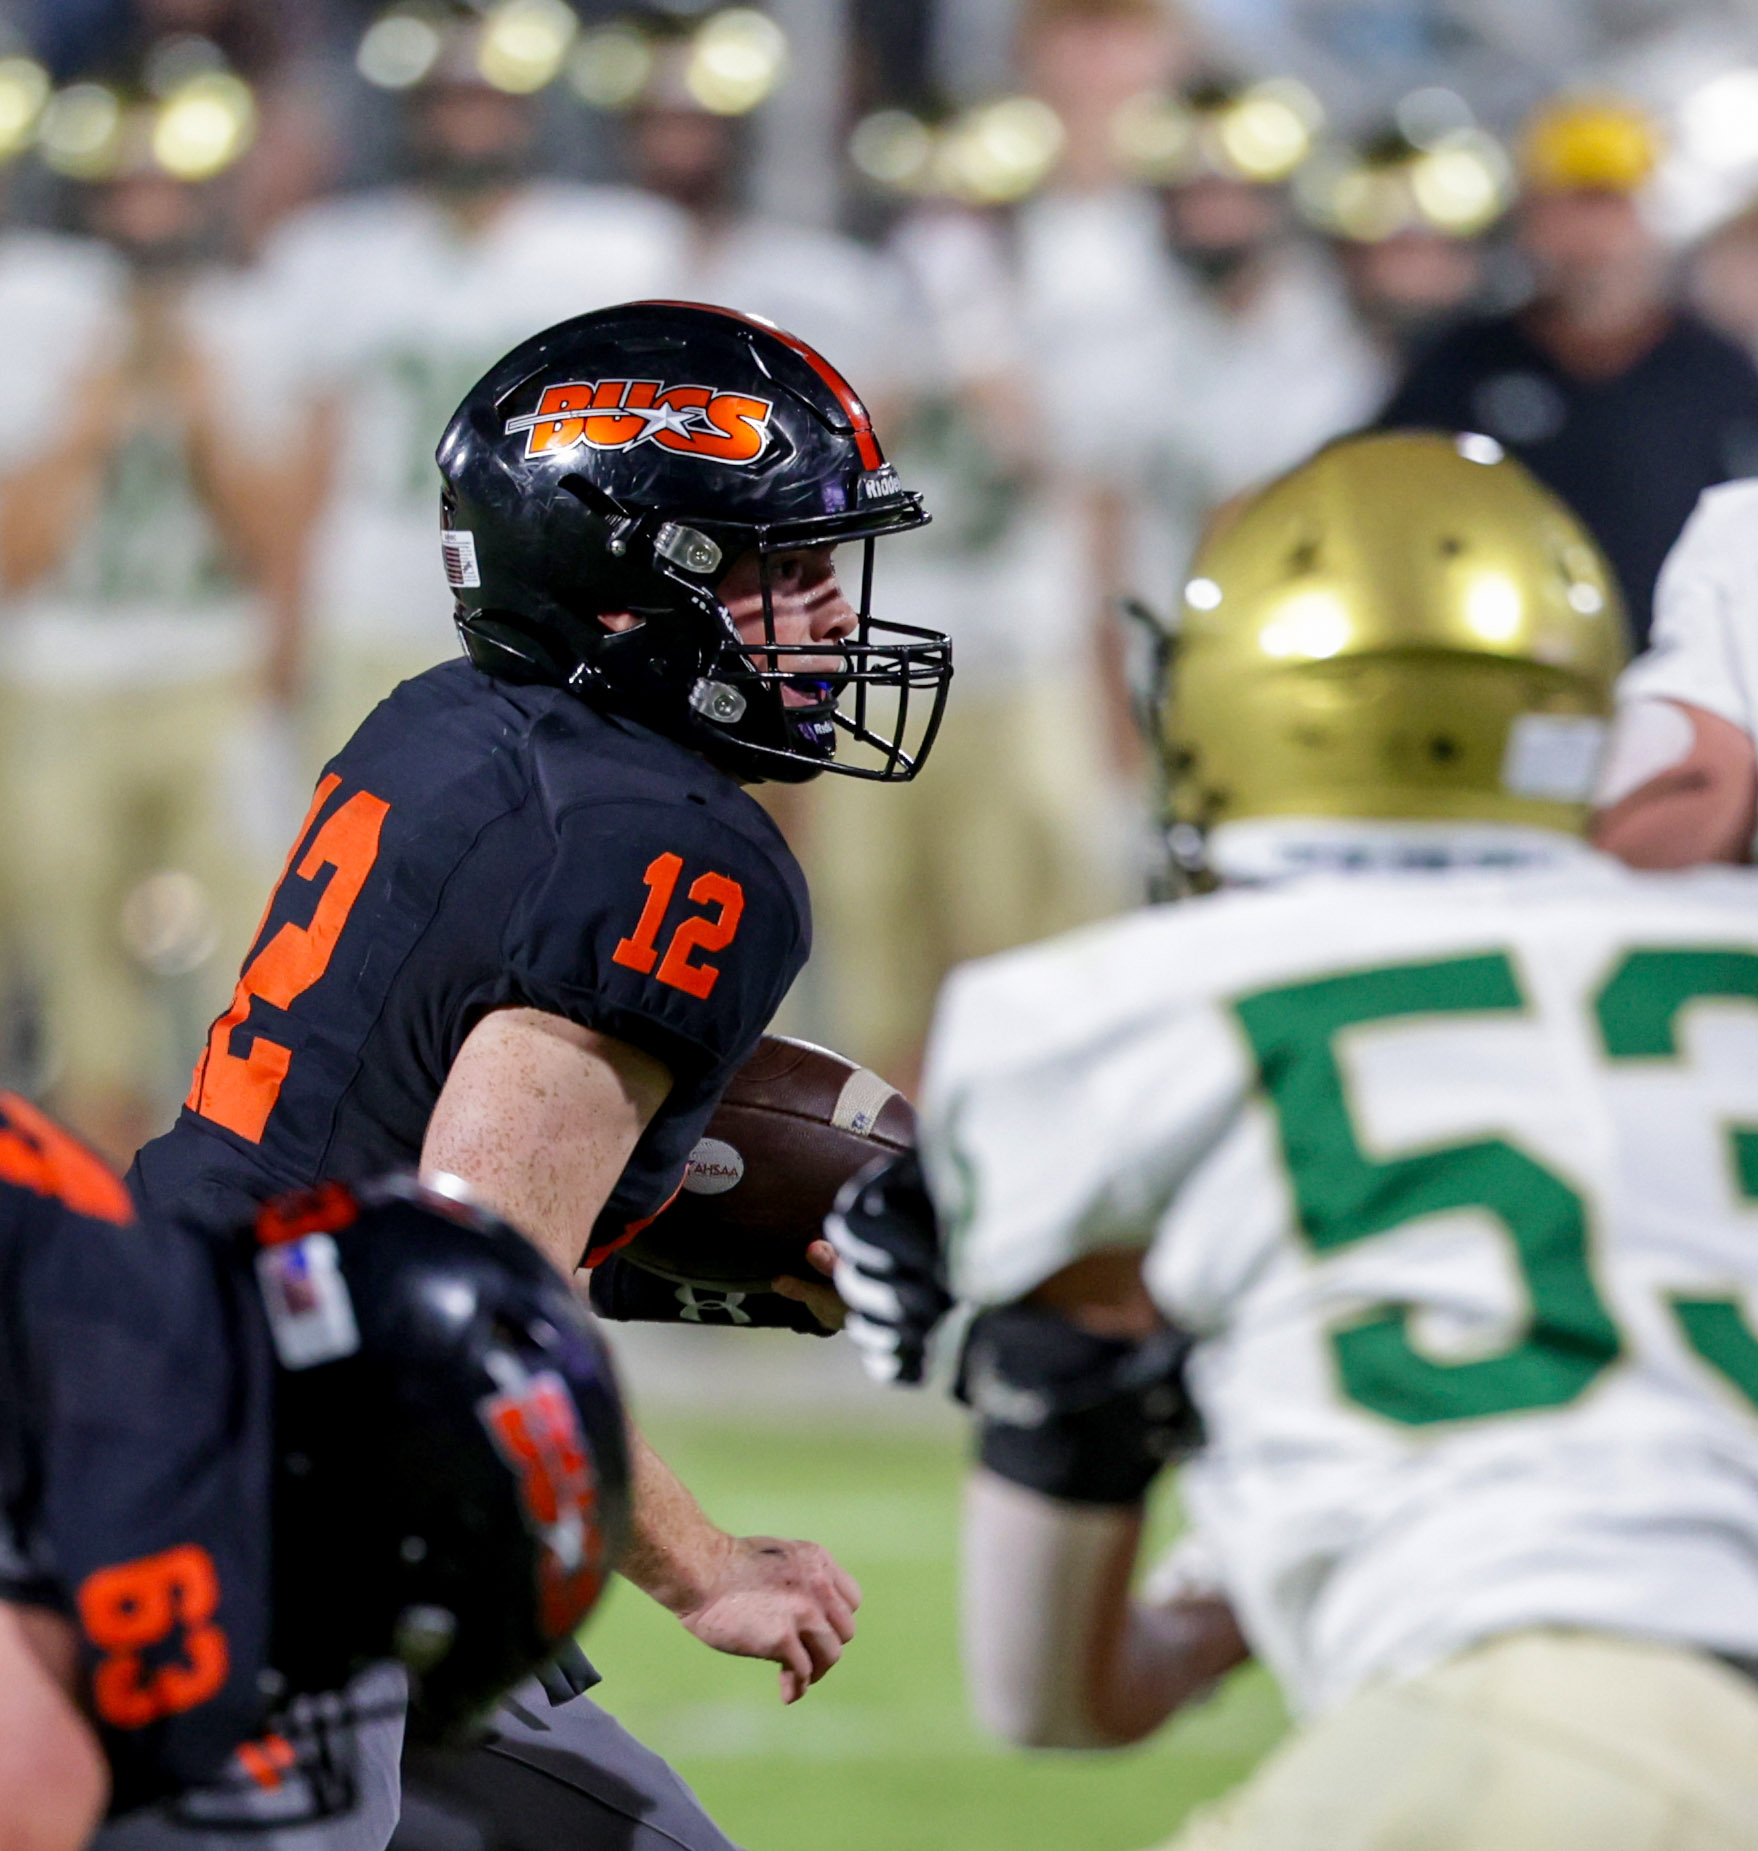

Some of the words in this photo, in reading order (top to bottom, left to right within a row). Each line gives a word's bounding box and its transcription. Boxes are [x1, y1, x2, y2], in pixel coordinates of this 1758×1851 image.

[518, 378, 774, 466] BUCS
[612, 851, 744, 999] 12
[694, 1162, 739, 1178] AHSAA
[77, 1544, 229, 1724] 63
